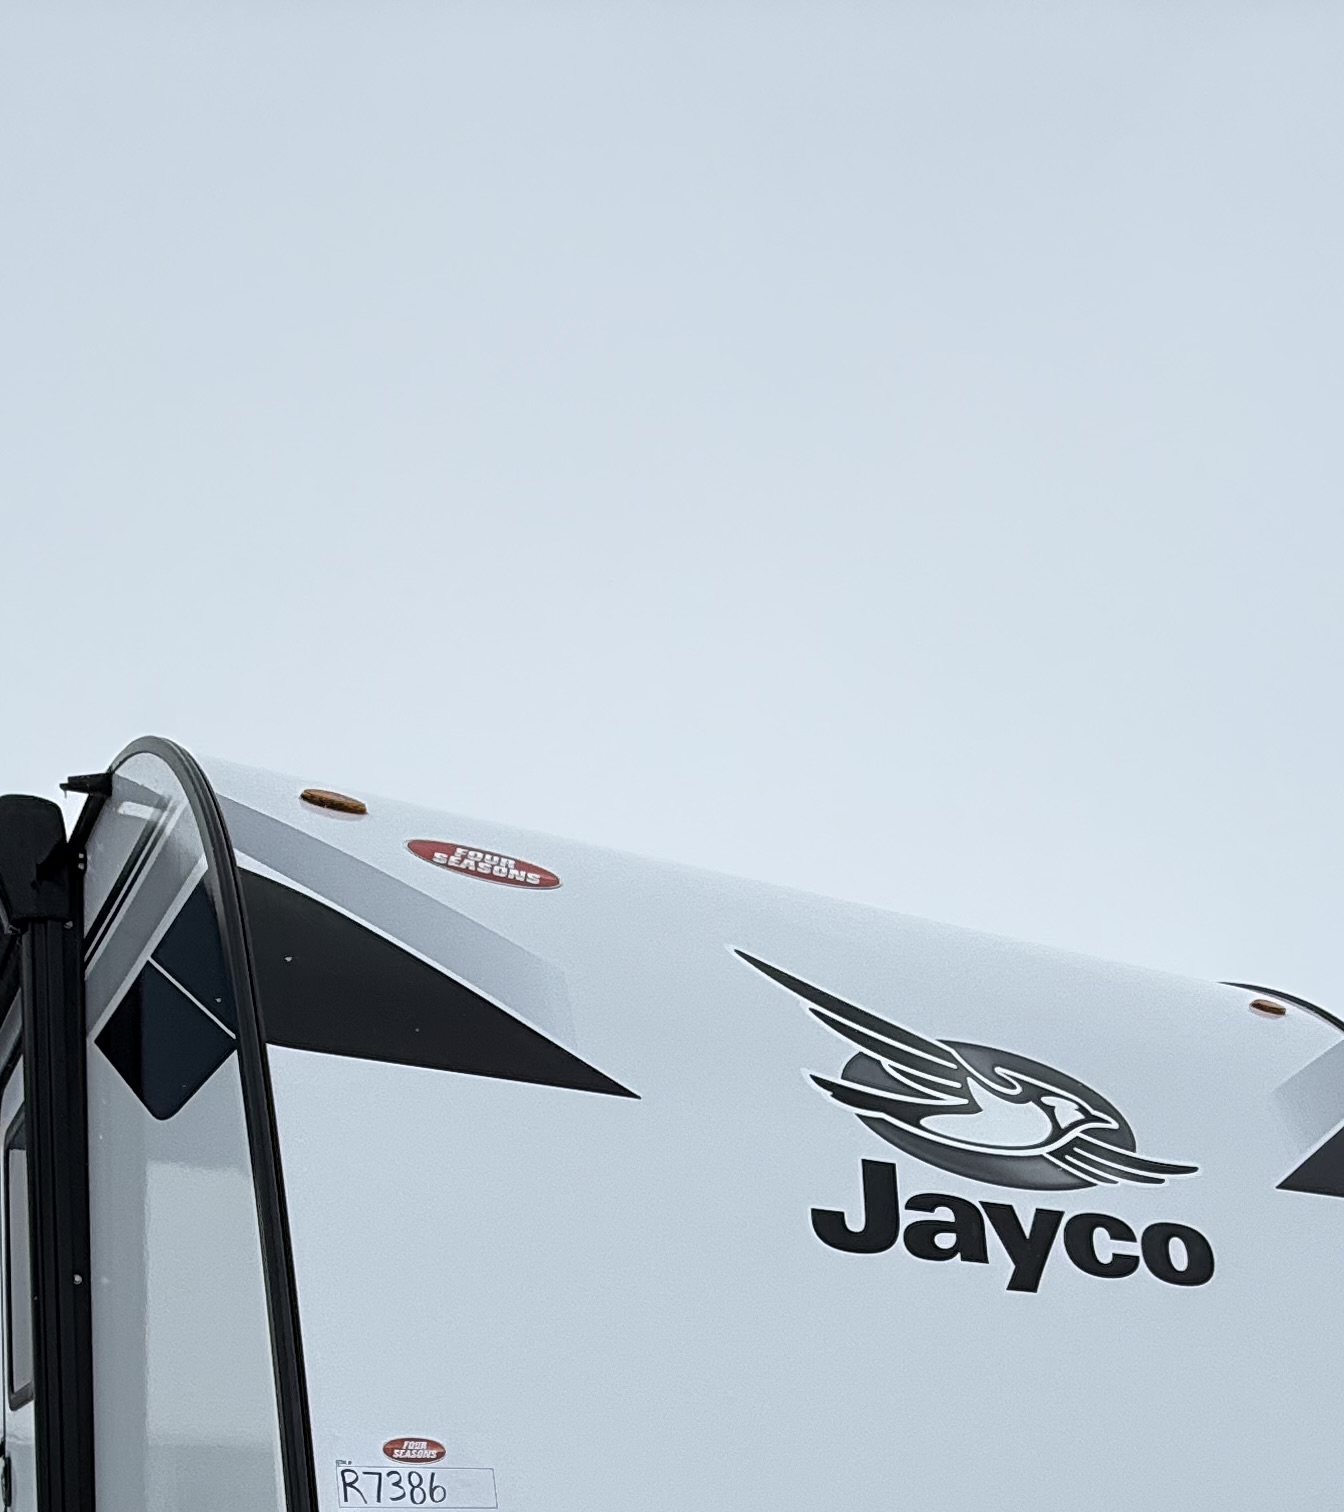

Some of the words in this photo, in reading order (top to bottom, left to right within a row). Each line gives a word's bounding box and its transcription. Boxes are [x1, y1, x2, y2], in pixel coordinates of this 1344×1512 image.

[432, 852, 541, 884] SEASONS
[455, 848, 516, 868] FOUR
[811, 1159, 1215, 1293] Jayco
[393, 1449, 437, 1459] SEASONS
[341, 1469, 446, 1504] R7386
